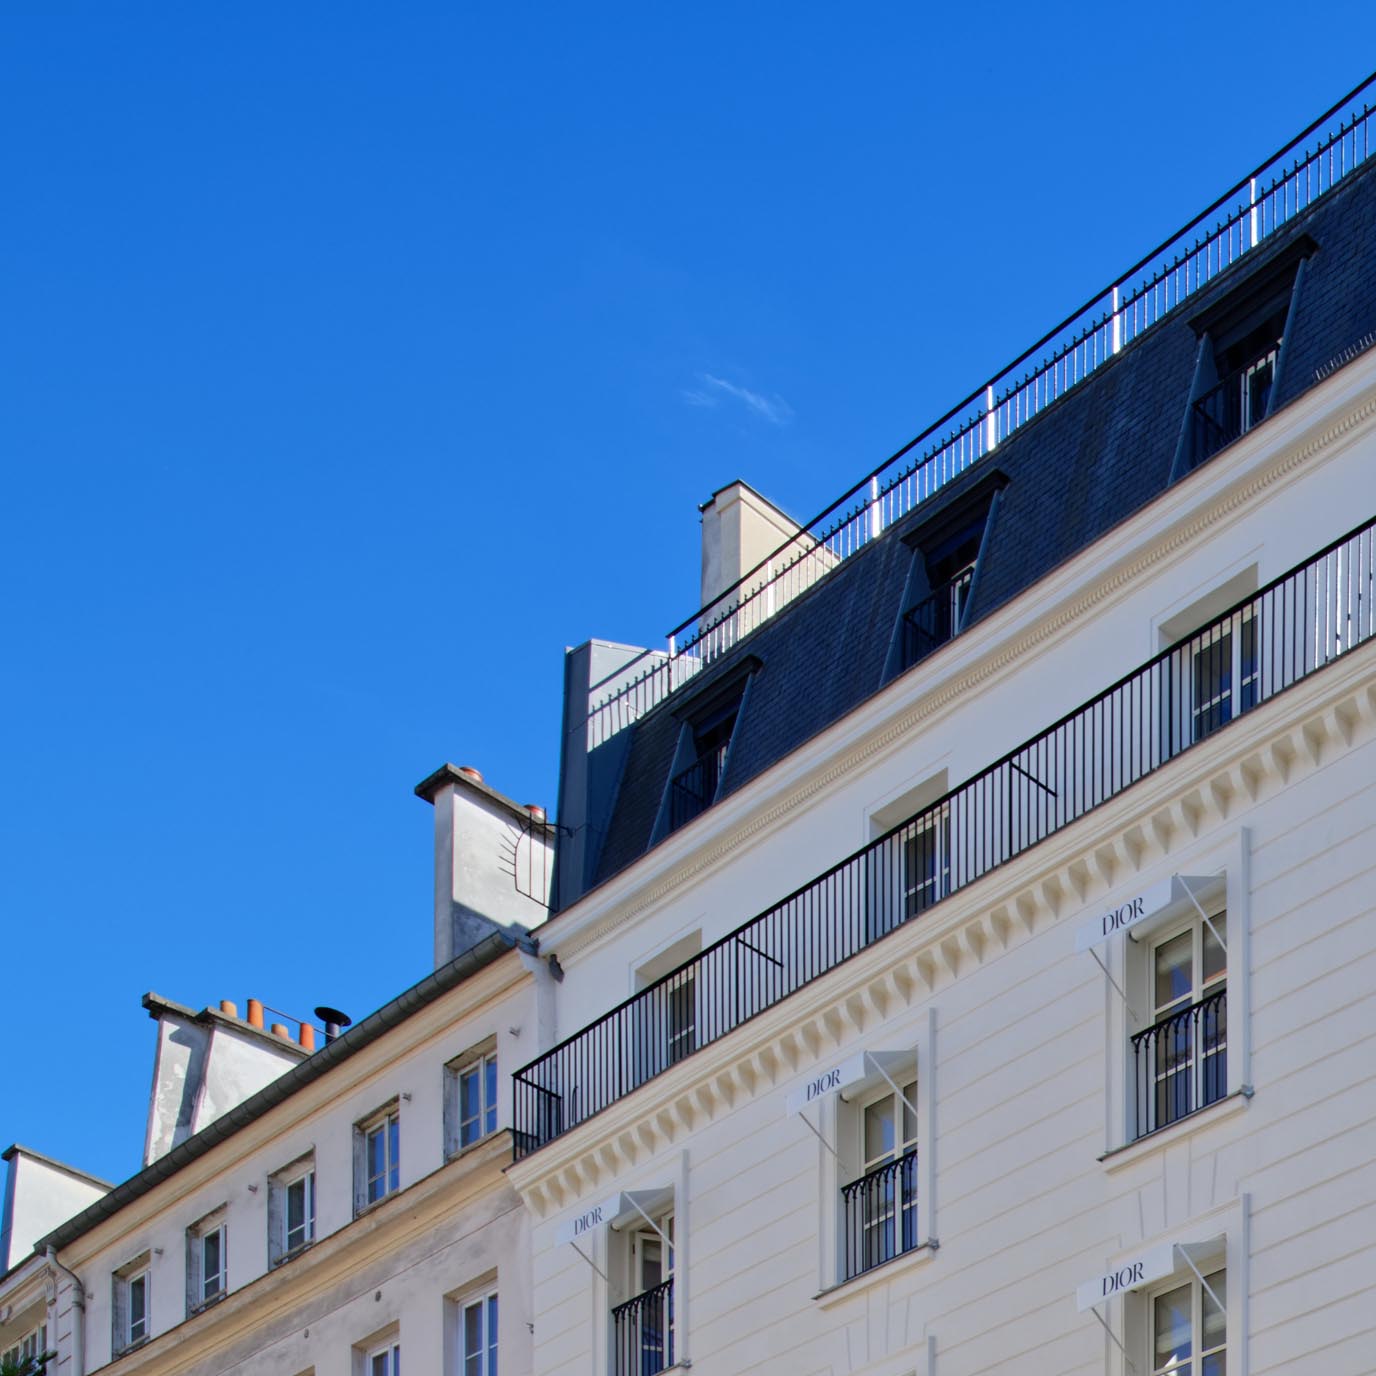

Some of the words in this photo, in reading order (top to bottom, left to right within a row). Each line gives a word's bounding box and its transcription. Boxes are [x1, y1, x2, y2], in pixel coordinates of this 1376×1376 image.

[1103, 897, 1144, 936] DIOR
[807, 1068, 840, 1101] DIOR
[574, 1207, 602, 1235] DIOR
[1102, 1263, 1144, 1296] DIOR
